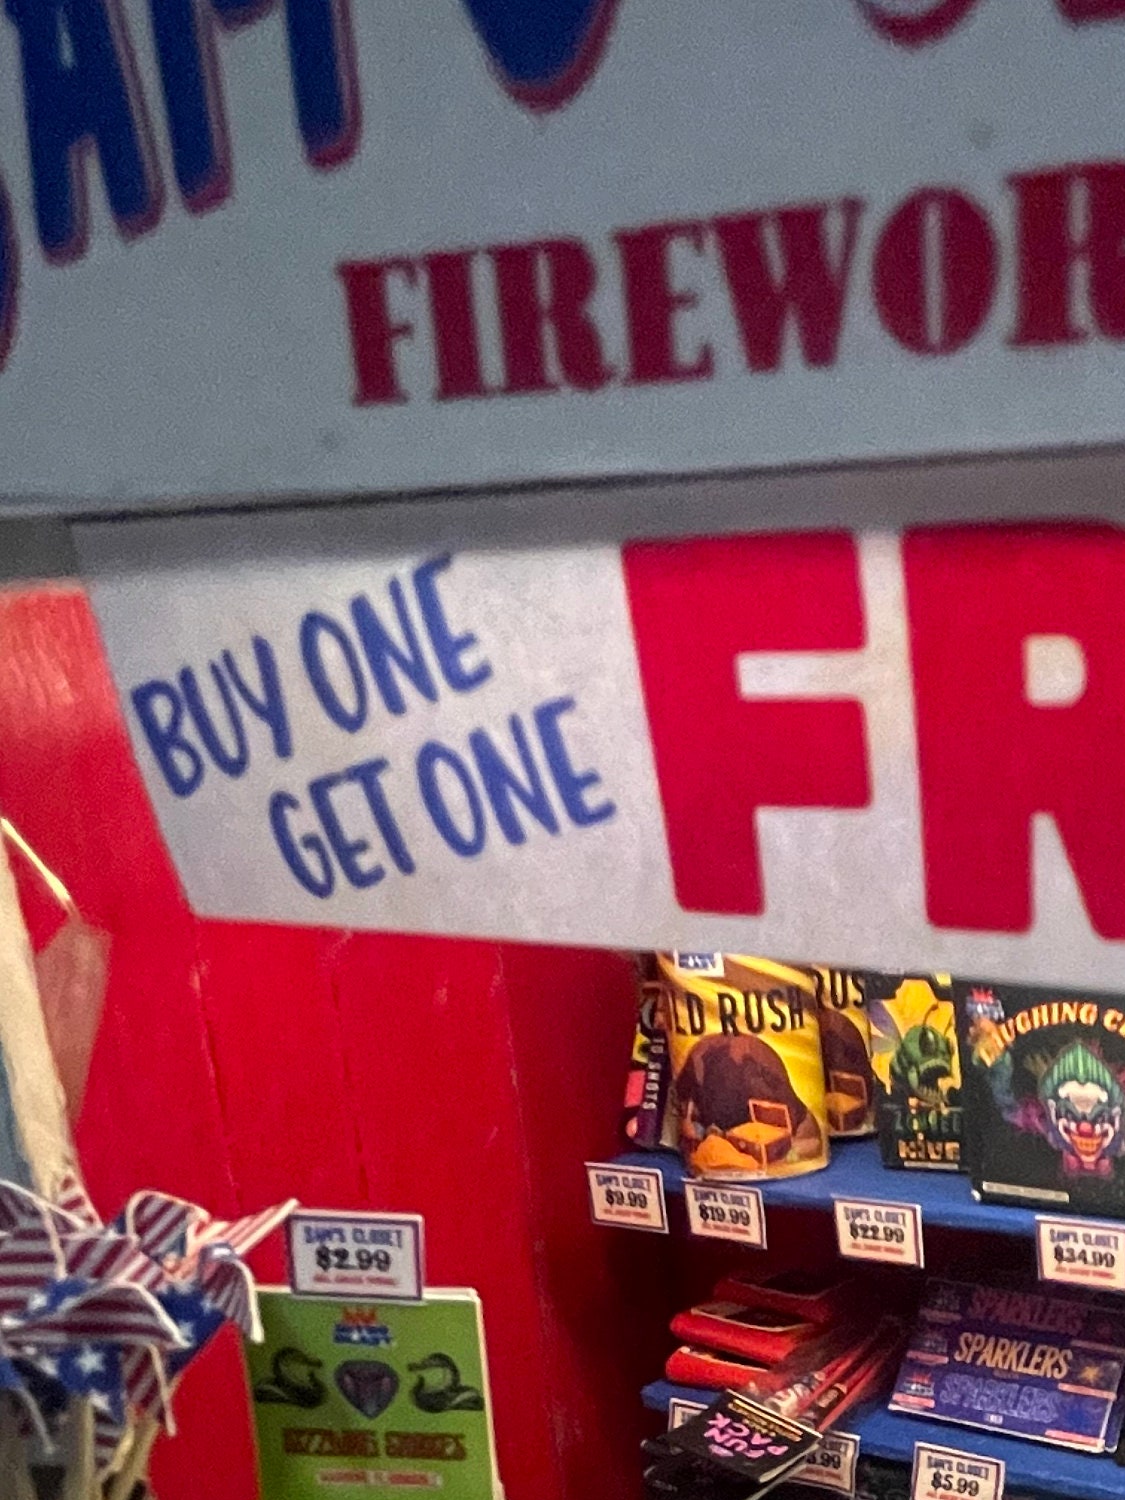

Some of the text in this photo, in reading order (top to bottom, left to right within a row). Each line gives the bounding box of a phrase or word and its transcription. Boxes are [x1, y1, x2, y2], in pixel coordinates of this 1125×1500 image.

[132, 553, 492, 798] BUY ONE
[270, 696, 617, 898] GET ONE
[814, 968, 868, 1009] RUS
[718, 988, 806, 1036] RUSH
[699, 1203, 751, 1226] $19.99
[850, 1222, 904, 1243] $22.99
[316, 1247, 392, 1272] $2.99
[1054, 1244, 1115, 1267] $34.99
[953, 1332, 1073, 1379] SPARKLERS
[931, 1471, 979, 1497] $5.99
